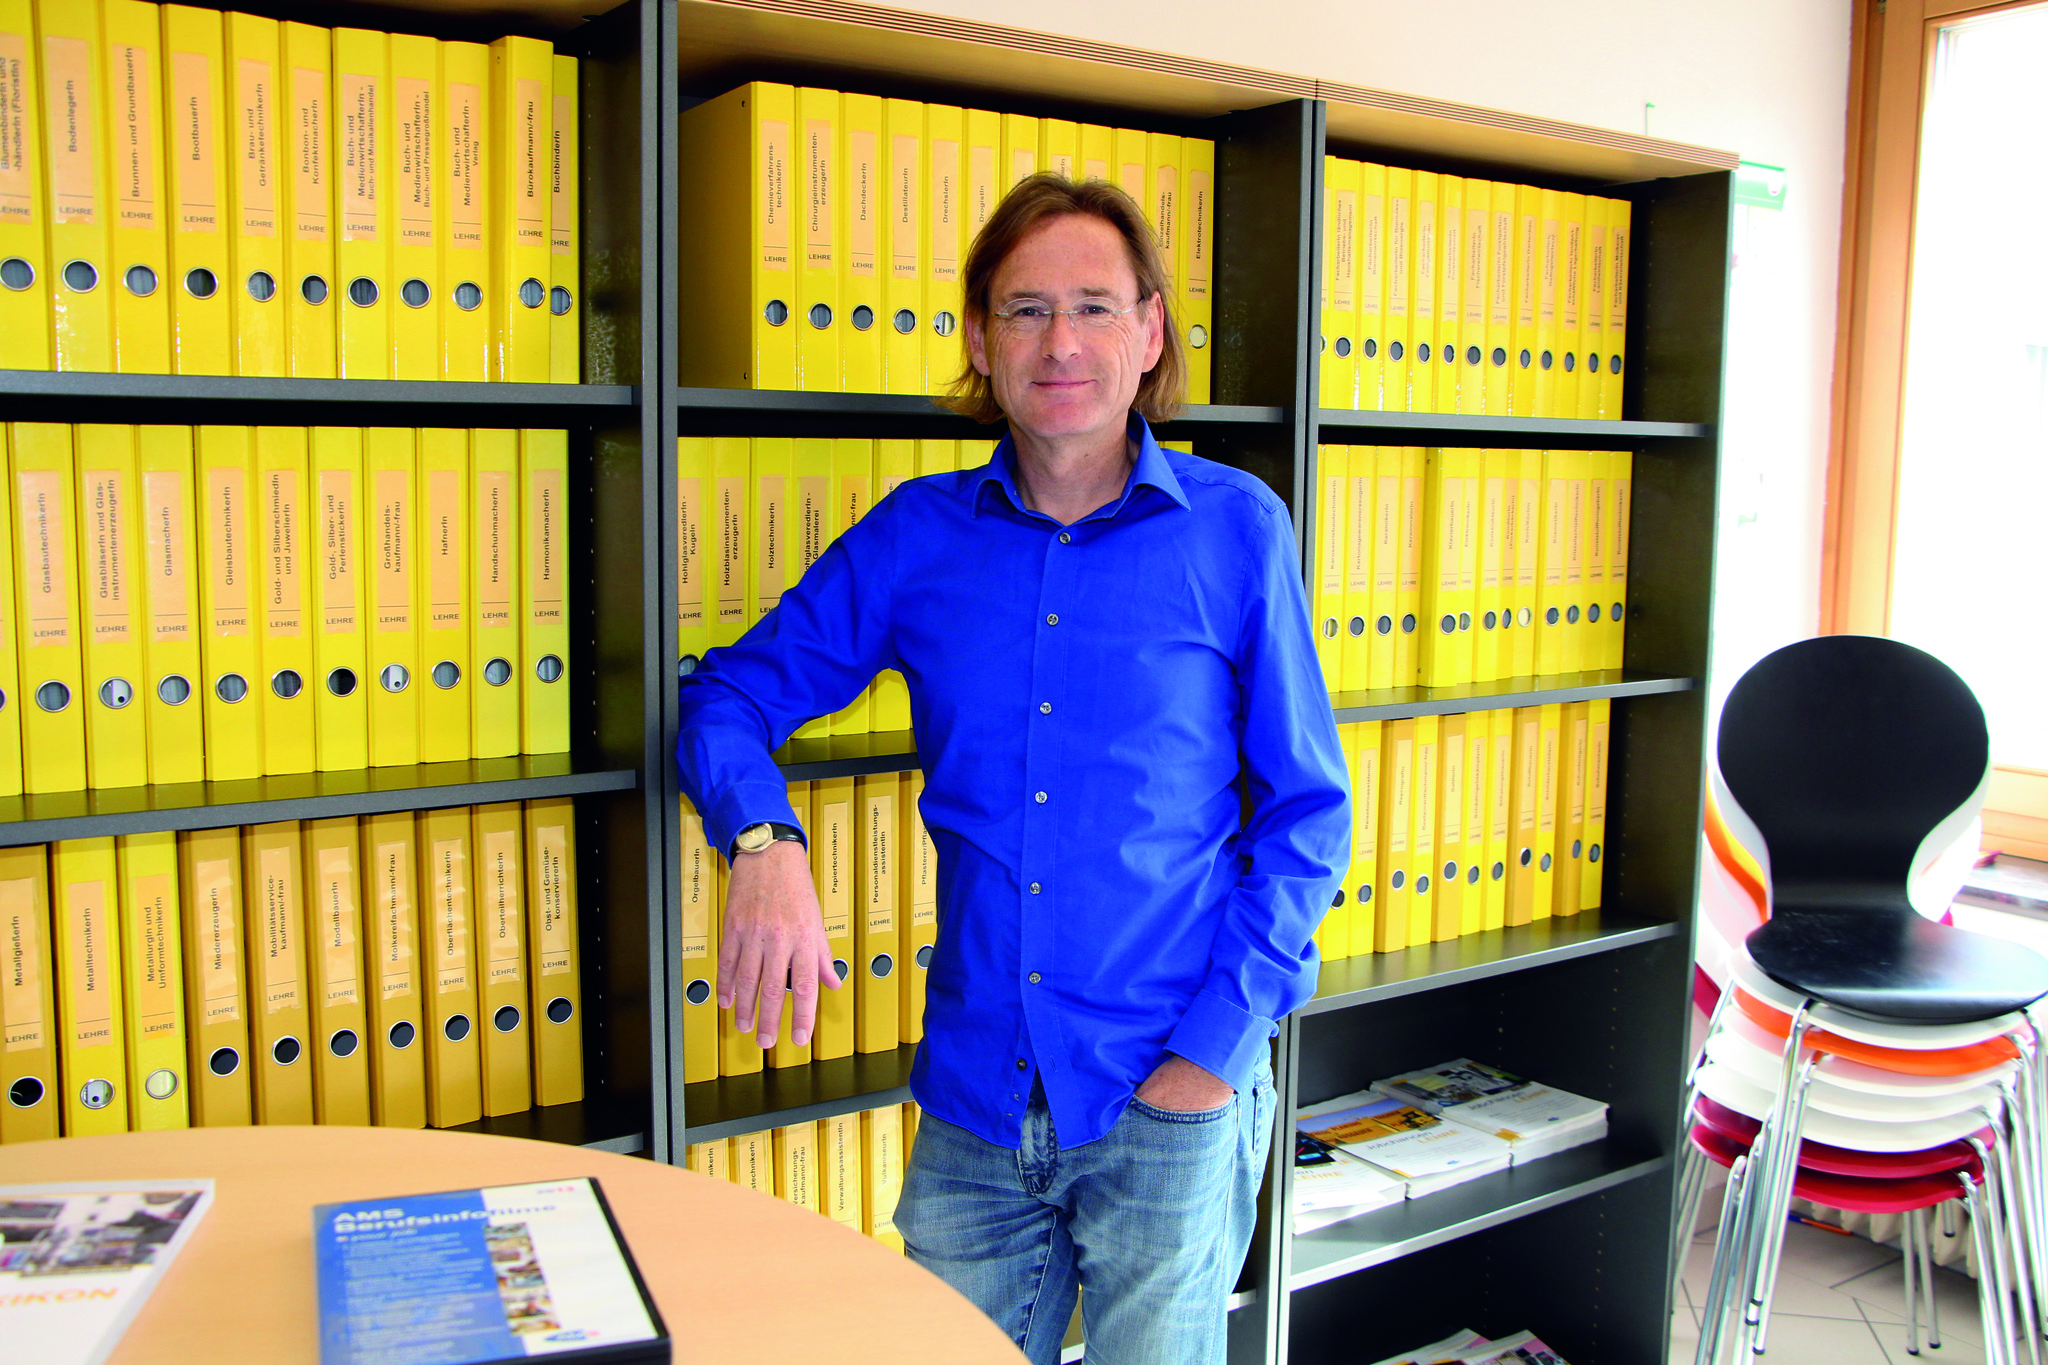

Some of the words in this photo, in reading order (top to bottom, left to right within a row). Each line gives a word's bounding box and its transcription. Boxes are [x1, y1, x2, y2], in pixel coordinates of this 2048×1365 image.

[11, 59, 22, 112] (FloristIn)
[126, 48, 136, 121] GrundbauerIn
[66, 80, 77, 152] BodenlegerIn
[191, 96, 200, 160] BootbauerIn
[256, 83, 266, 186] GetränketechnikerIn
[462, 104, 470, 206] MedienwirtschafterIn
[131, 148, 139, 197] Brunnen-
[59, 206, 93, 215] LEHRE
[122, 211, 152, 220] LEHRE
[184, 216, 215, 224] LEHRE
[246, 220, 273, 228] LEHRE
[299, 224, 325, 233] LEHRE
[347, 224, 376, 232] LEHRE
[519, 230, 543, 238] LEHRE
[96, 512, 104, 532] und
[272, 474, 280, 552] SilberschmiedIn
[38, 493, 51, 594] GlasbautechnikerIn
[107, 479, 120, 600] instrumentenerzeugerIn
[162, 507, 172, 576] GlasmacherIn
[223, 486, 233, 585] GleisbautechnikerIn
[338, 501, 346, 573] PerlenstickerIn
[98, 535, 108, 598] GlasbläserIn
[34, 629, 67, 638] LEHRE
[390, 854, 398, 961] Molkereifachmann/-frau
[445, 850, 453, 956] OberflächentechnikerIn
[143, 907, 151, 924] und
[268, 875, 277, 958] Mobilitätsservice-
[278, 879, 287, 950] kaufmann/-frau
[332, 882, 341, 947] ModellbauerIn
[870, 918, 890, 926] LEHRE
[210, 888, 221, 970] MiedererzeugerIn
[11, 916, 23, 986] MetallgießerIn
[84, 907, 94, 991] MetalltechnikerIn
[156, 896, 166, 989] UmformtechnikerIn
[145, 927, 155, 982] MetallurgIn
[543, 960, 568, 968] LEHRE
[439, 977, 464, 986] LEHRE
[492, 968, 517, 976] LEHRE
[269, 992, 295, 1001] LEHRE
[328, 989, 354, 999] LEHRE
[383, 982, 408, 992] LEHRE
[208, 1006, 235, 1016] LEHRE
[6, 1033, 38, 1043] LEHRE
[78, 1030, 109, 1040] LEHRE
[145, 1023, 175, 1033] LEHRE
[1514, 1089, 1550, 1103] LEHRE
[1367, 1130, 1432, 1150] Jobchancen
[1418, 1130, 1460, 1143] LEHRE
[333, 1208, 404, 1224] AMS
